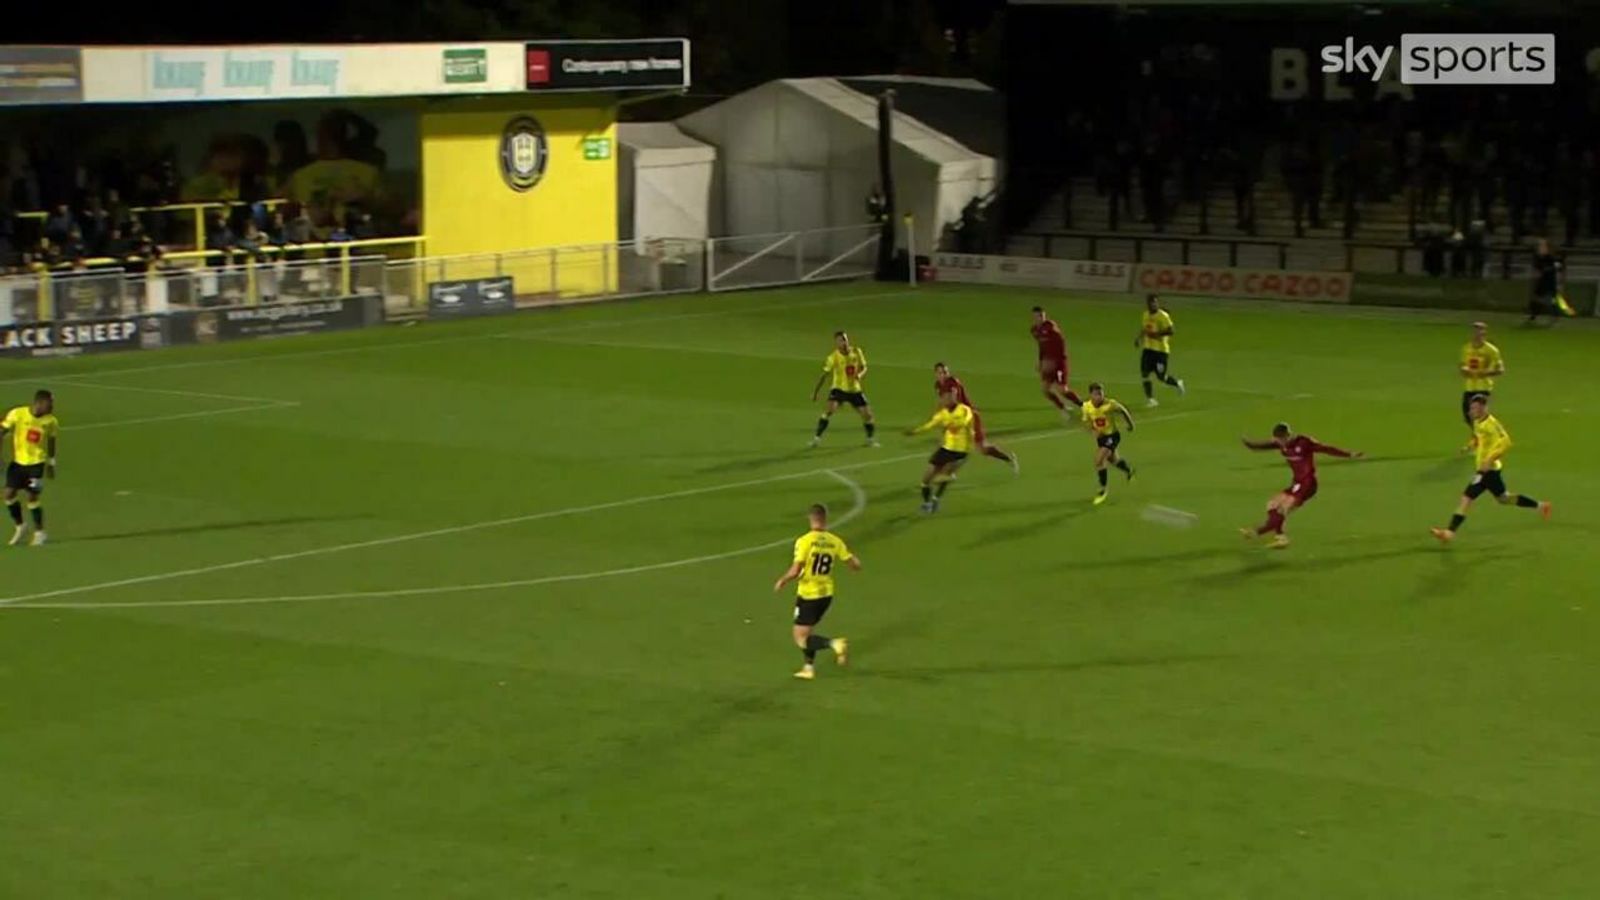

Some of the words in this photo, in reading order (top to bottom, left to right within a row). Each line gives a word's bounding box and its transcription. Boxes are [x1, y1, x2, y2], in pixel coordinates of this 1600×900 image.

[1139, 269, 1235, 292] CAZOO
[1244, 272, 1345, 297] CAZOO
[61, 320, 137, 345] SHEEP
[811, 552, 833, 576] 18
